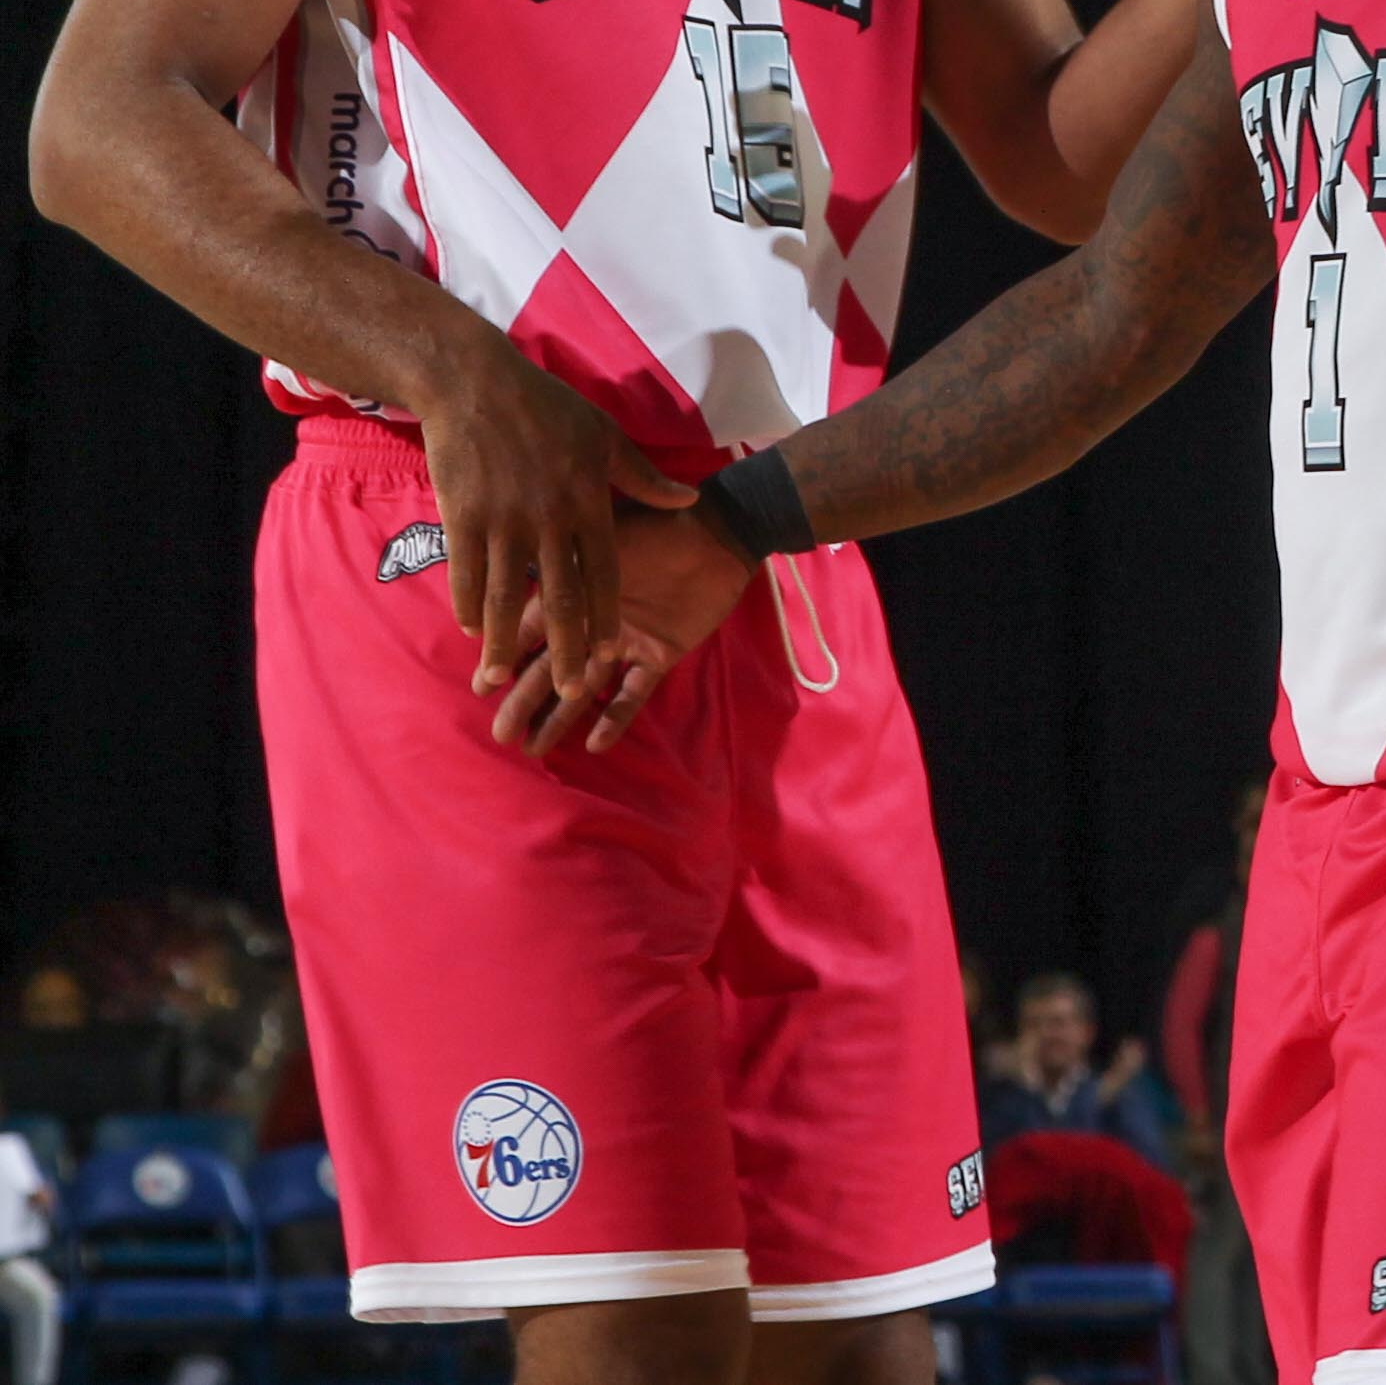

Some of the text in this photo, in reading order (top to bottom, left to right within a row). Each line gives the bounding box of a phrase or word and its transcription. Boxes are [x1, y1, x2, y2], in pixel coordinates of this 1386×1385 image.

[325, 92, 365, 226] march
[682, 14, 806, 229] 15
[1302, 251, 1348, 473] 1
[463, 1135, 571, 1190] 76ers
